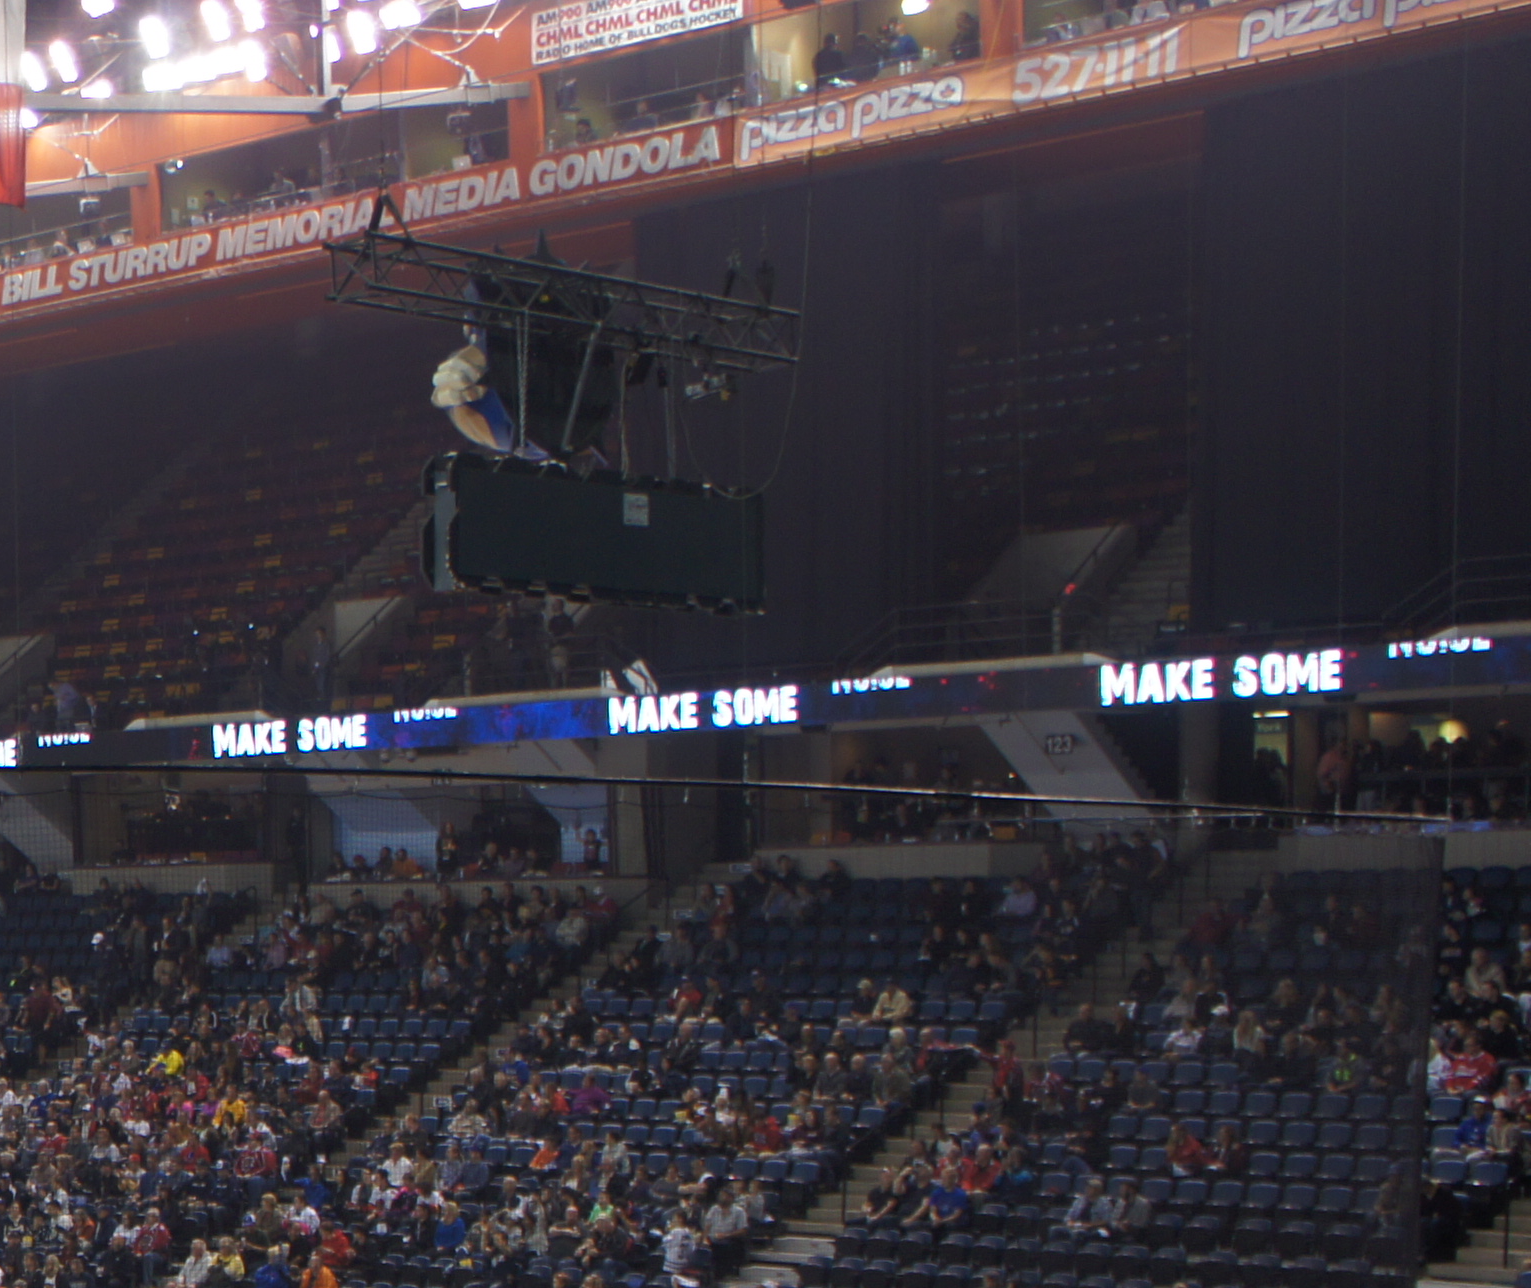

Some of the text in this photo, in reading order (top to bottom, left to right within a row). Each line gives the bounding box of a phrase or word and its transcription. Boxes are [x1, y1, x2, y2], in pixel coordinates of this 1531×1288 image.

[535, 45, 570, 61] RADIO
[574, 37, 605, 52] HOME
[608, 33, 623, 45] OF
[689, 7, 736, 27] HOCKEY
[536, 1, 684, 47] CHML CHML CHML
[741, 100, 845, 161] pizza
[851, 76, 964, 138] pizza
[1, 126, 721, 305] BILL STURRUP MEMORIAL MEDIA GONDOLA
[1100, 649, 1344, 706] MAKE SOME
[212, 720, 286, 759] MAKE
[297, 713, 367, 752] SOME
[608, 691, 699, 735] MAKE
[711, 685, 799, 729] SOME
[1045, 735, 1073, 756] 123
